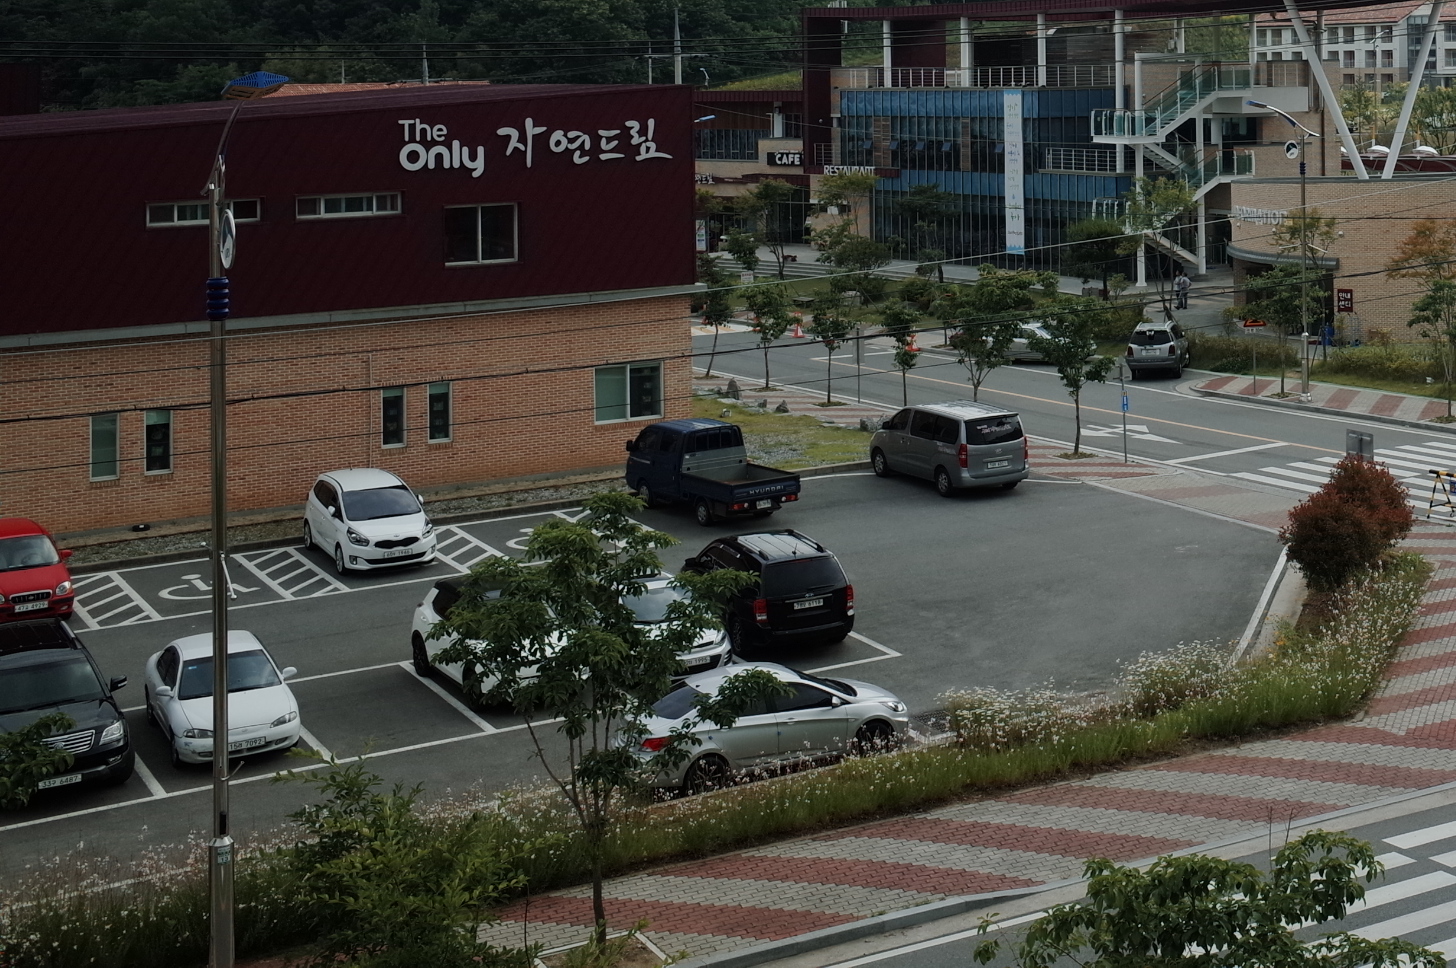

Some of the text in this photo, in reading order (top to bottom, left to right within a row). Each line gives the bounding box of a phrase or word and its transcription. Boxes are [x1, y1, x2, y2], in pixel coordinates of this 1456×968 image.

[398, 118, 447, 141] The
[496, 117, 673, 168] 자연드림
[775, 153, 801, 165] CAFE
[749, 485, 784, 495] HYUNDAI
